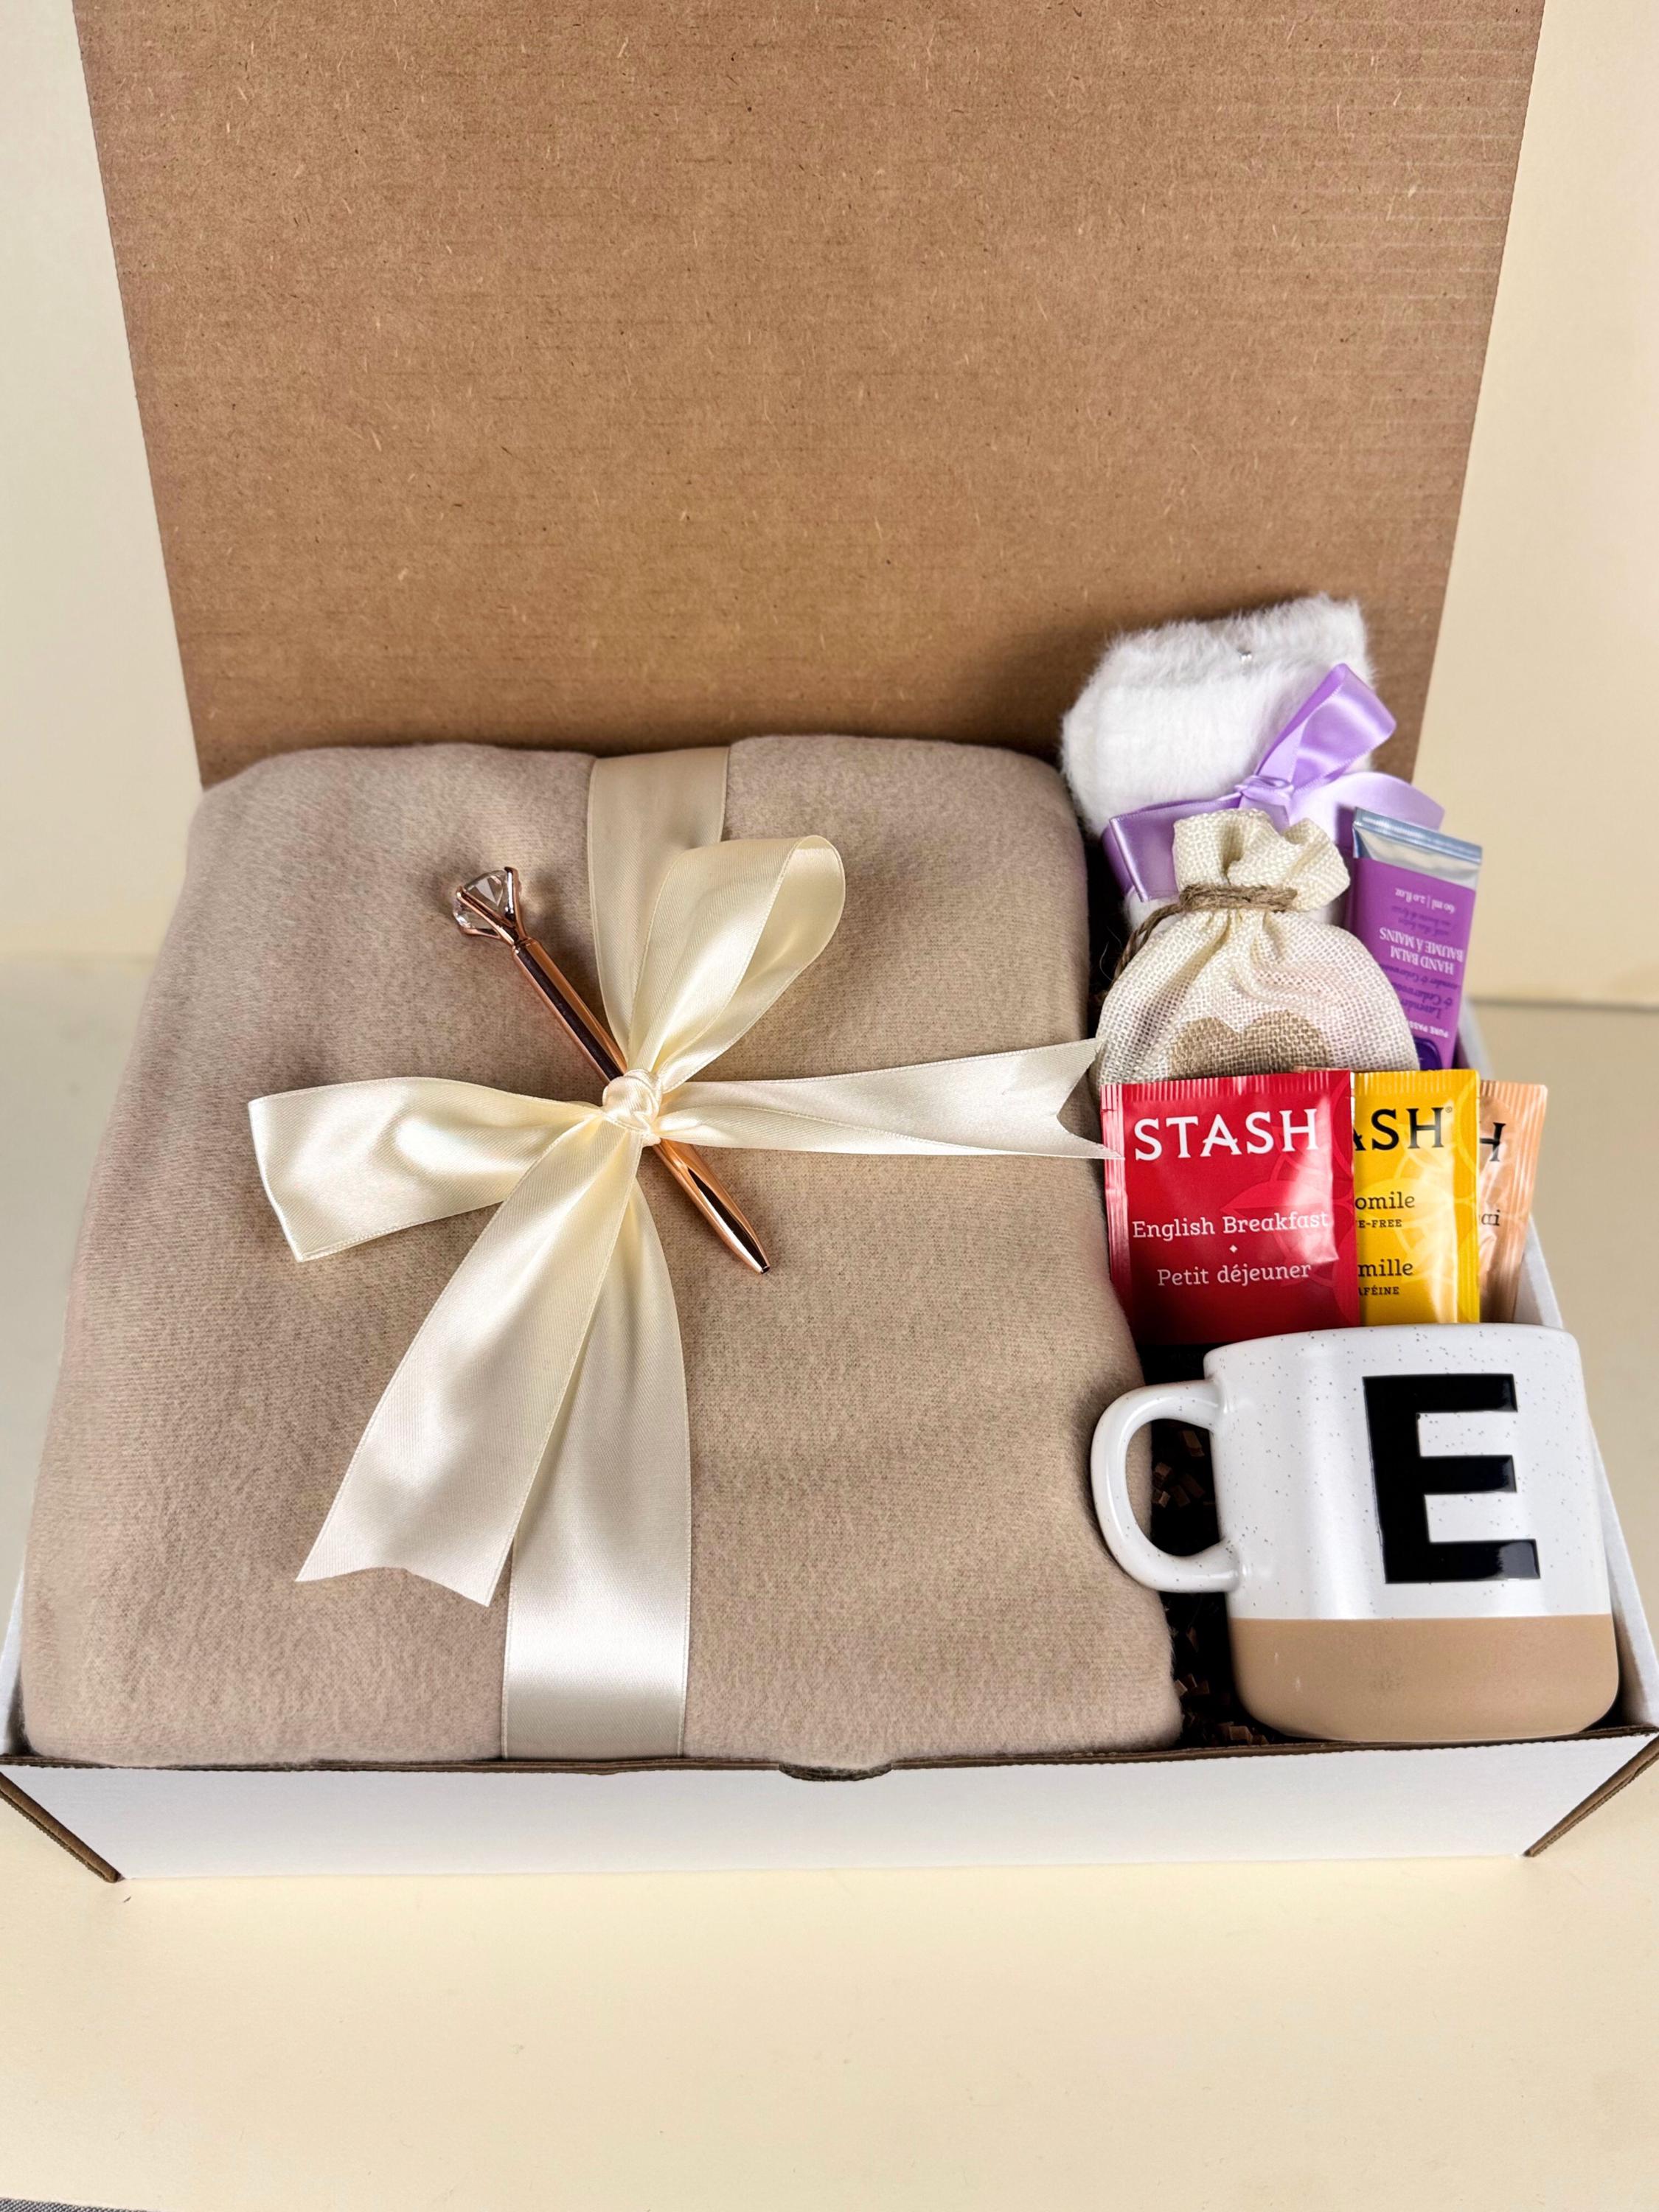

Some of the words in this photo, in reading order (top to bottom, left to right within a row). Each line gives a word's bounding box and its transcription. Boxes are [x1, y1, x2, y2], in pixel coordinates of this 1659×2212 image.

[1380, 927, 1416, 949] MAINS
[1390, 945, 1420, 966] BALM
[1425, 941, 1464, 962] BAUME
[1420, 955, 1455, 975] HAND
[1133, 1108, 1318, 1161] STASH
[1354, 1192, 1415, 1210] omile
[1132, 1217, 1215, 1241] English
[1222, 1211, 1329, 1234] Breakfast
[1157, 1267, 1208, 1286] Petit
[1217, 1263, 1312, 1287] déjeuner
[1357, 1259, 1413, 1277] mille
[1363, 1374, 1540, 1584] E
